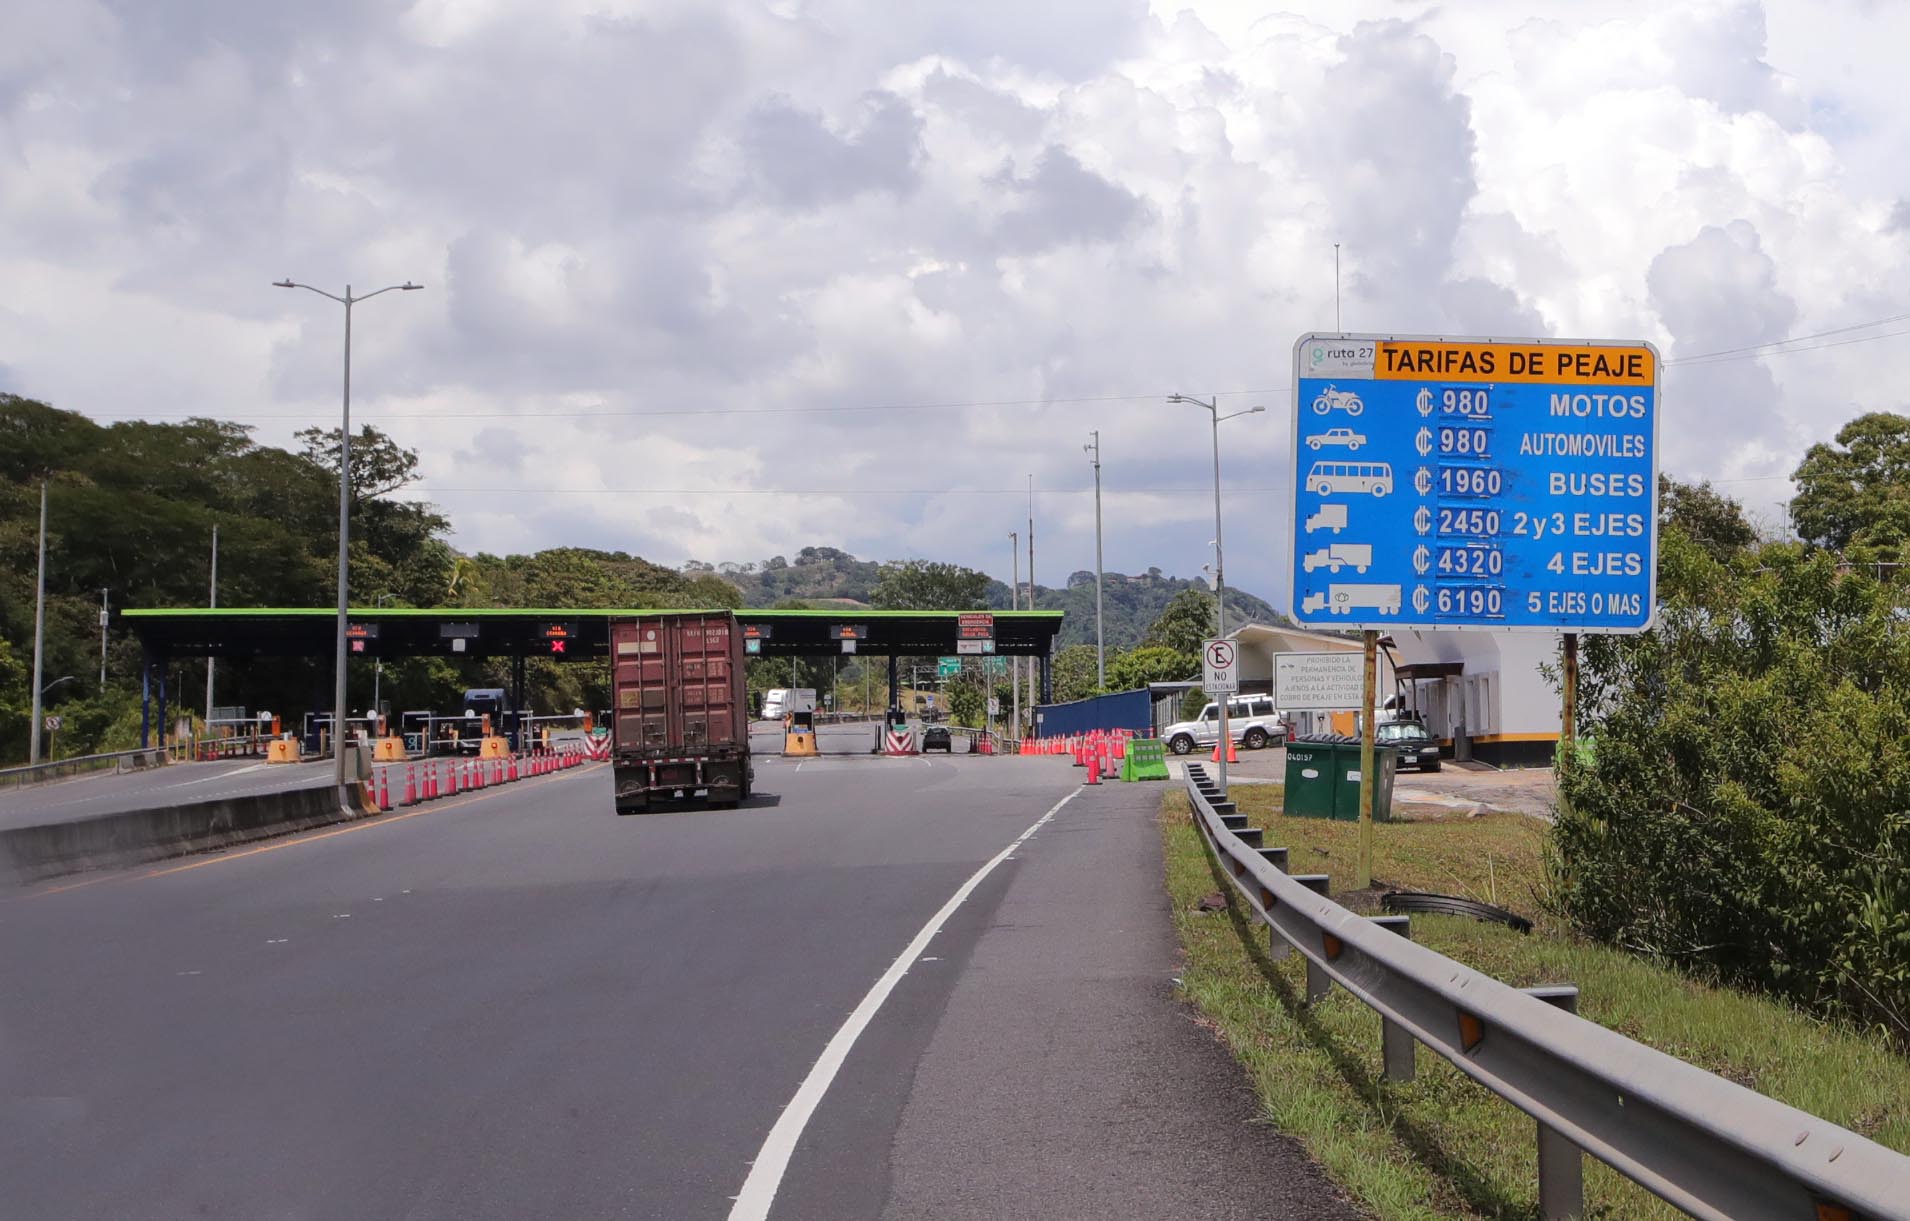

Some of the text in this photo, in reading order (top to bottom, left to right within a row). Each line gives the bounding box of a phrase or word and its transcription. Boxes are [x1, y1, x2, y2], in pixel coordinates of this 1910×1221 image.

[1327, 348, 1373, 359] ruta 27
[1383, 349, 1643, 377] TARIFAS DE PEAJE
[1443, 391, 1488, 414] 980
[1550, 394, 1646, 417] MOTOS
[1441, 430, 1486, 453] 980
[1519, 433, 1645, 457] AUTOMOVILES
[1442, 470, 1501, 494] 1960
[1550, 473, 1644, 496] BUSES
[1440, 511, 1499, 534] 2450
[1513, 512, 1528, 534] 2
[1551, 513, 1565, 534] 3
[1574, 513, 1643, 536] EJES
[1439, 552, 1502, 574] 4320
[1547, 552, 1565, 574] 4
[1572, 552, 1642, 575] EJES
[1438, 590, 1501, 613] 6190
[1528, 591, 1542, 613] 5
[1549, 592, 1586, 613] EJES
[1608, 593, 1641, 615] MAS
[1307, 656, 1340, 664] PROHIBIDO
[1205, 683, 1236, 691] ESTACIONAR
[1214, 672, 1226, 681] NO
